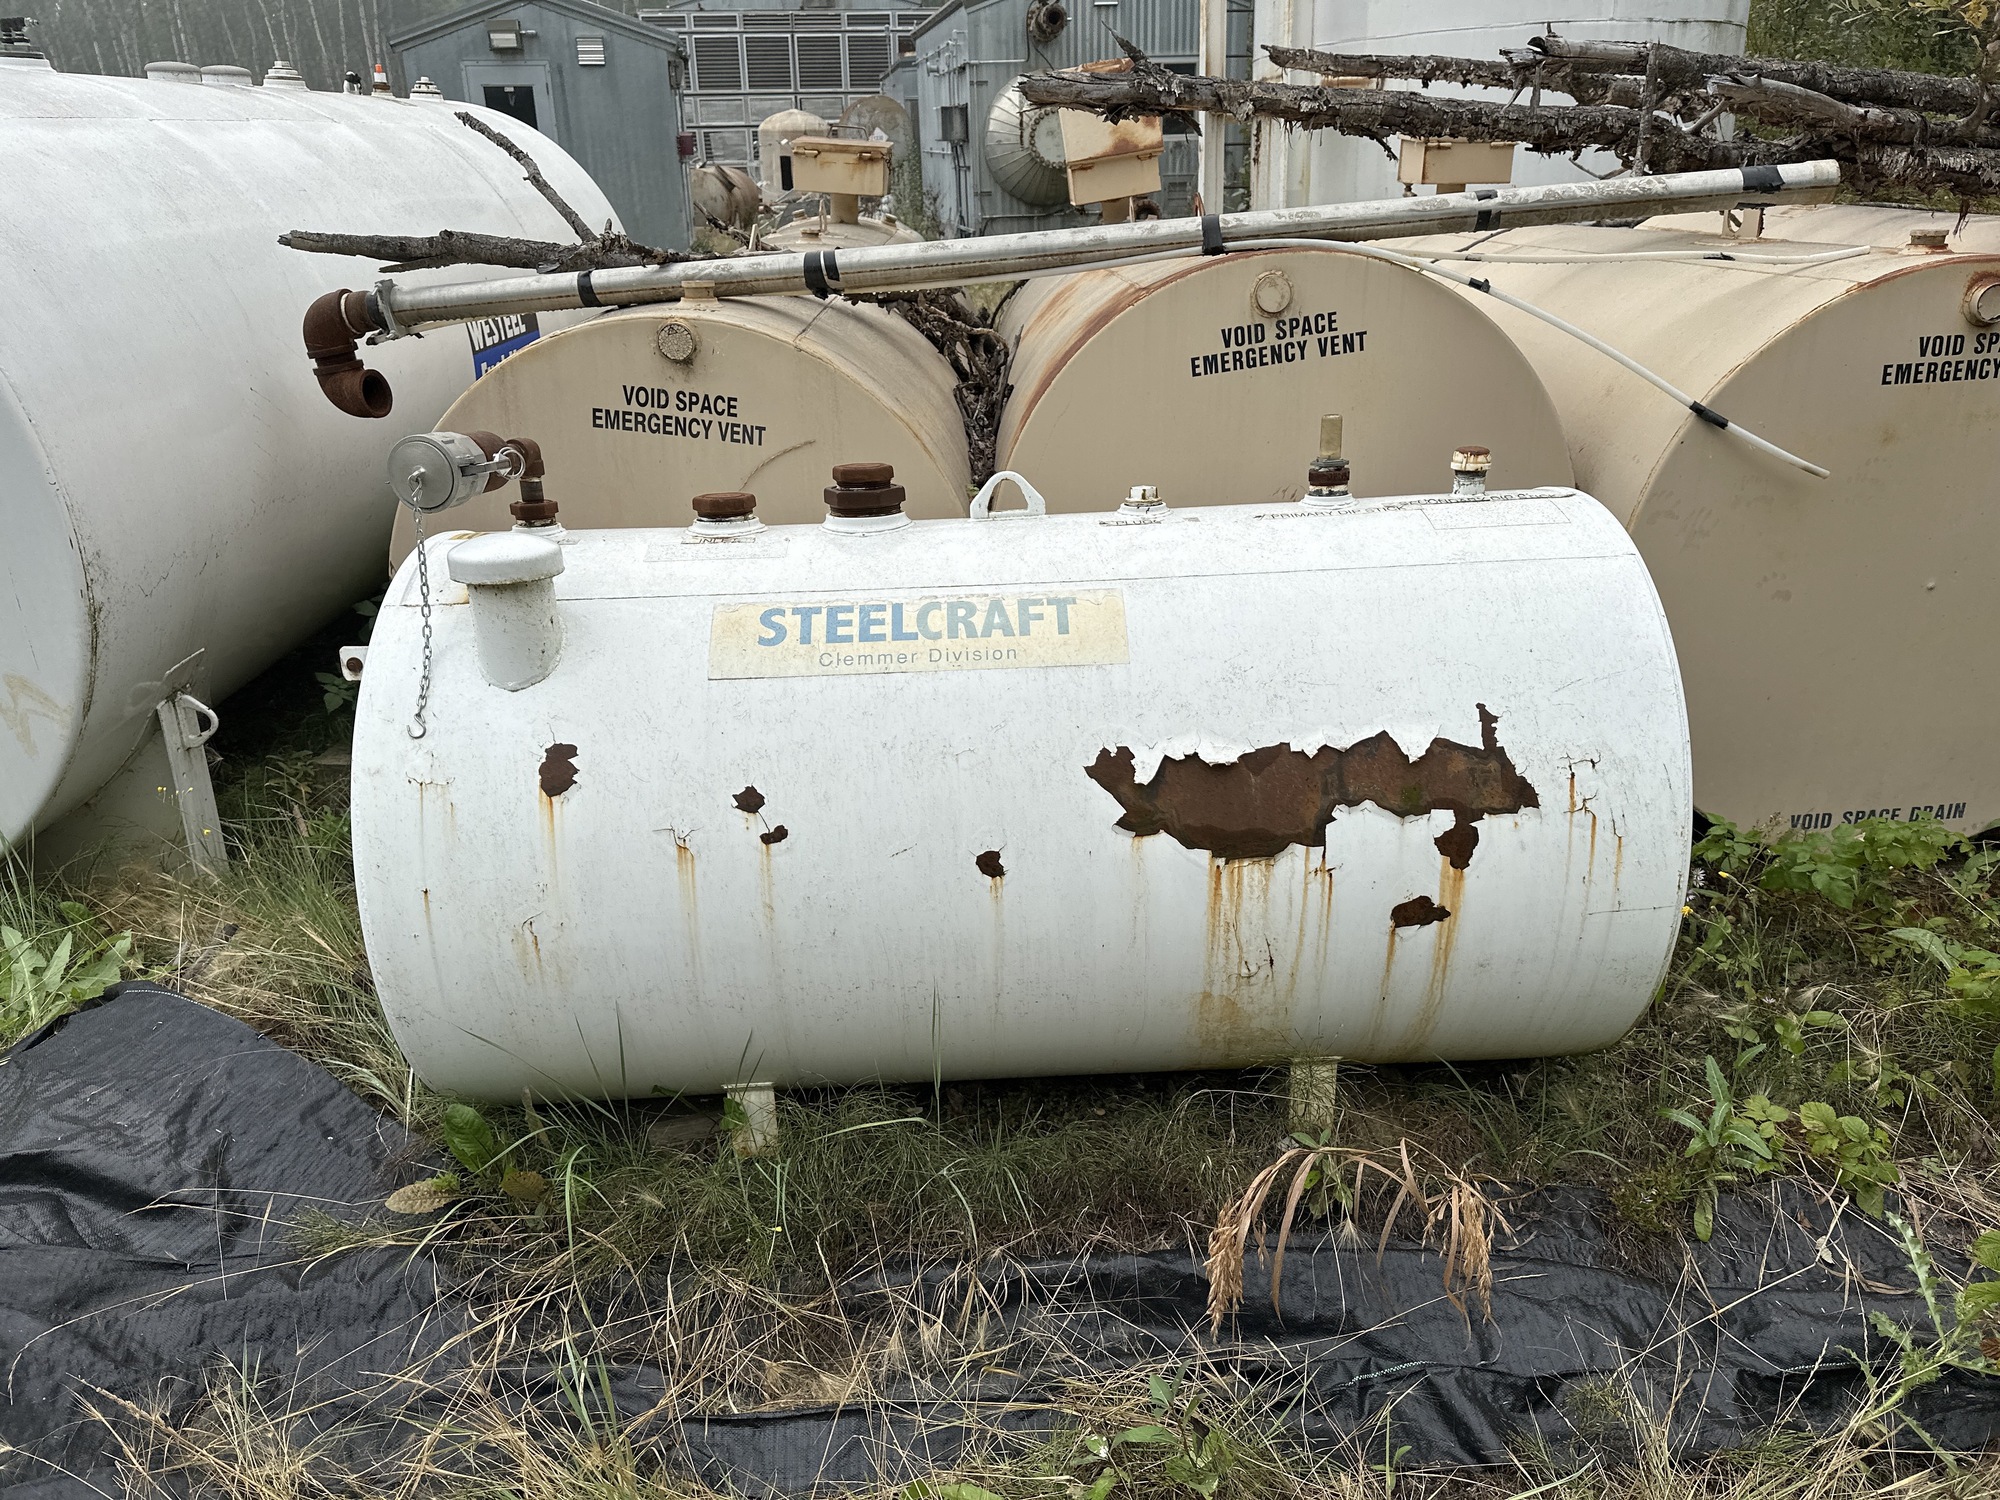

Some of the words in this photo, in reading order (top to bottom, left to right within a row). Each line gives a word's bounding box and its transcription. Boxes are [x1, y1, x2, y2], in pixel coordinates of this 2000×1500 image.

[467, 314, 527, 351] WESTEEL
[1221, 323, 1265, 349] VOID
[1275, 311, 1338, 340] SPACE
[1919, 334, 1965, 357] VOID
[1973, 332, 2000, 354] SP
[1190, 339, 1308, 377] EMERGENCY
[1317, 330, 1368, 357] VENT
[1881, 357, 2000, 385] EMERGENCY
[622, 384, 669, 409] VOID
[675, 390, 738, 418] SPACE
[592, 407, 713, 440] EMERGENCY
[718, 421, 766, 446] VENT
[1270, 510, 1333, 519] PRIMARY
[1338, 508, 1361, 516] DIP
[1364, 504, 1407, 514] STICK
[757, 597, 1077, 647] STEELCRAFT
[818, 650, 918, 668] Clemmer
[929, 645, 1017, 663] Division
[1790, 812, 1832, 830] VOID
[1841, 807, 1901, 825] SPACE
